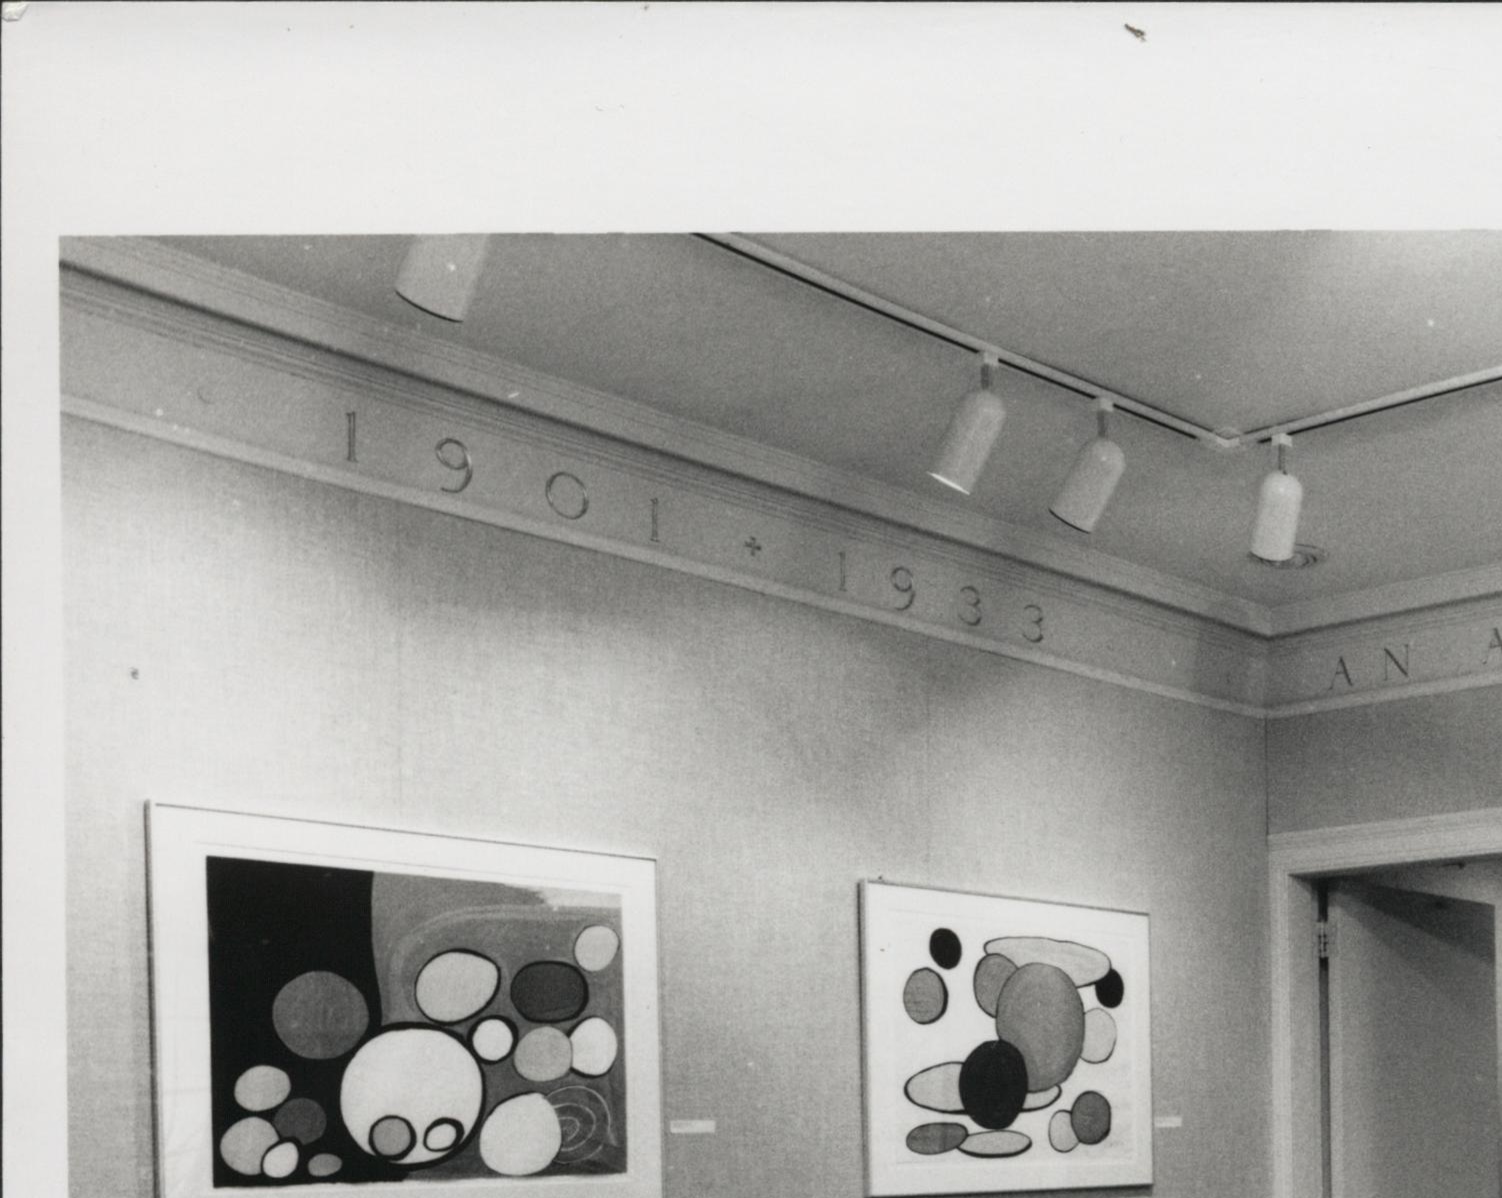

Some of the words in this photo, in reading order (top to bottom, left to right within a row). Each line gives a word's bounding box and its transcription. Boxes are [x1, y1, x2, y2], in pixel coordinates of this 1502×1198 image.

[345, 410, 660, 543] 1901
[837, 550, 1045, 644] 1933
[1327, 643, 1412, 691] AN
